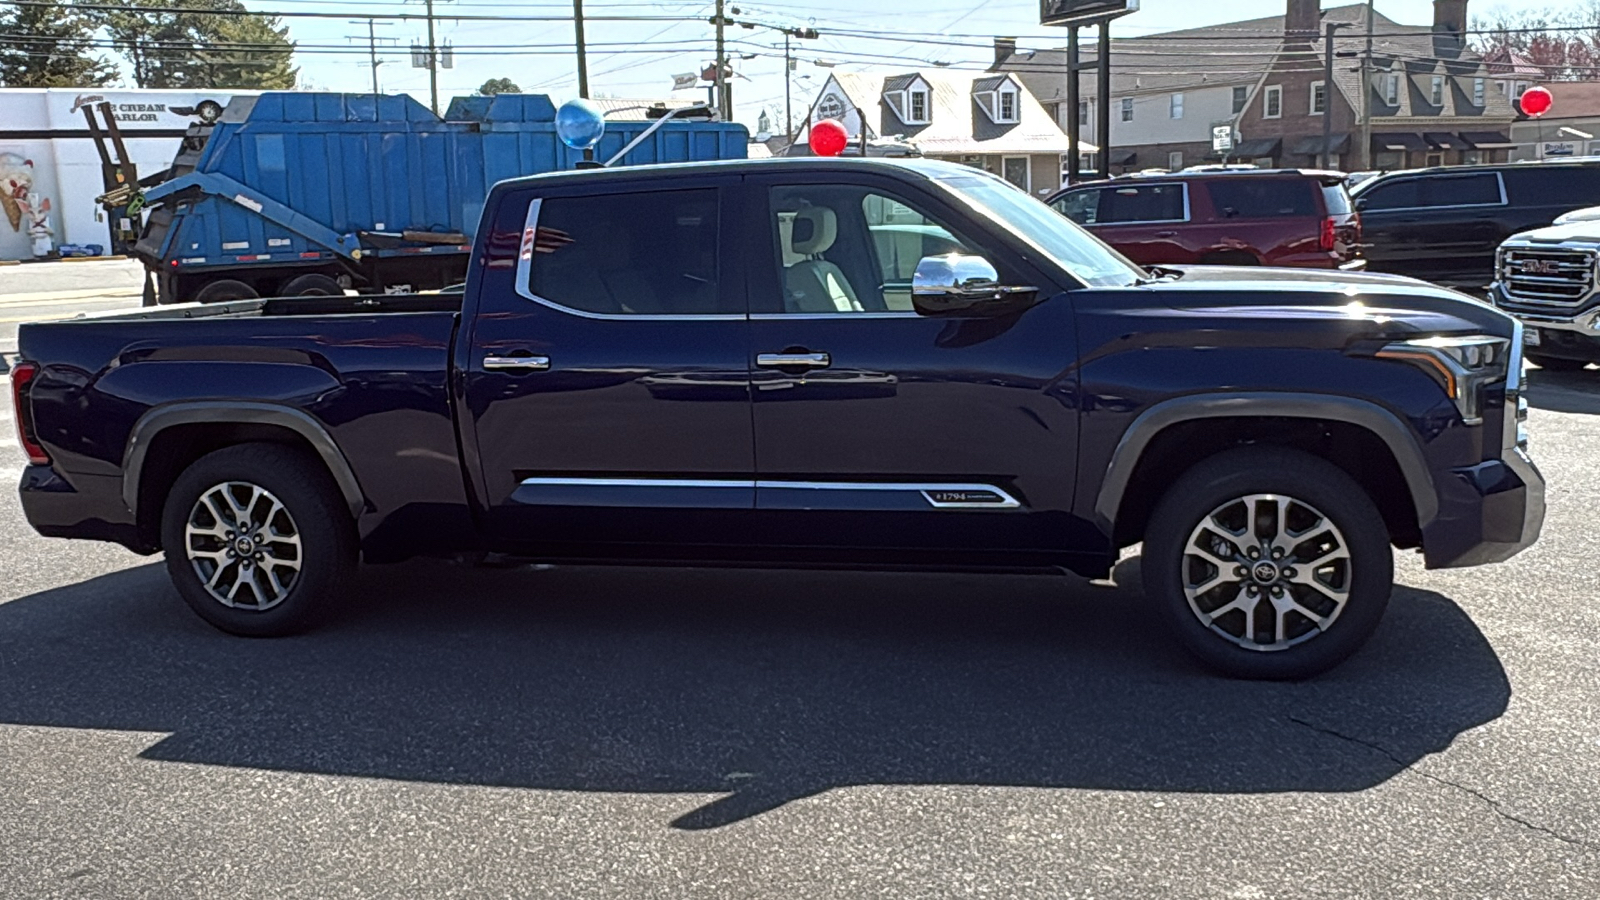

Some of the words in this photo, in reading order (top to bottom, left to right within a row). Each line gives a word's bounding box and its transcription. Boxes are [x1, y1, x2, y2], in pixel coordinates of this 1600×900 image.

[96, 104, 117, 112] IE
[119, 104, 166, 112] CREAM
[112, 113, 158, 121] ARLOR
[1521, 259, 1559, 273] GMC
[942, 492, 966, 500] 1794
